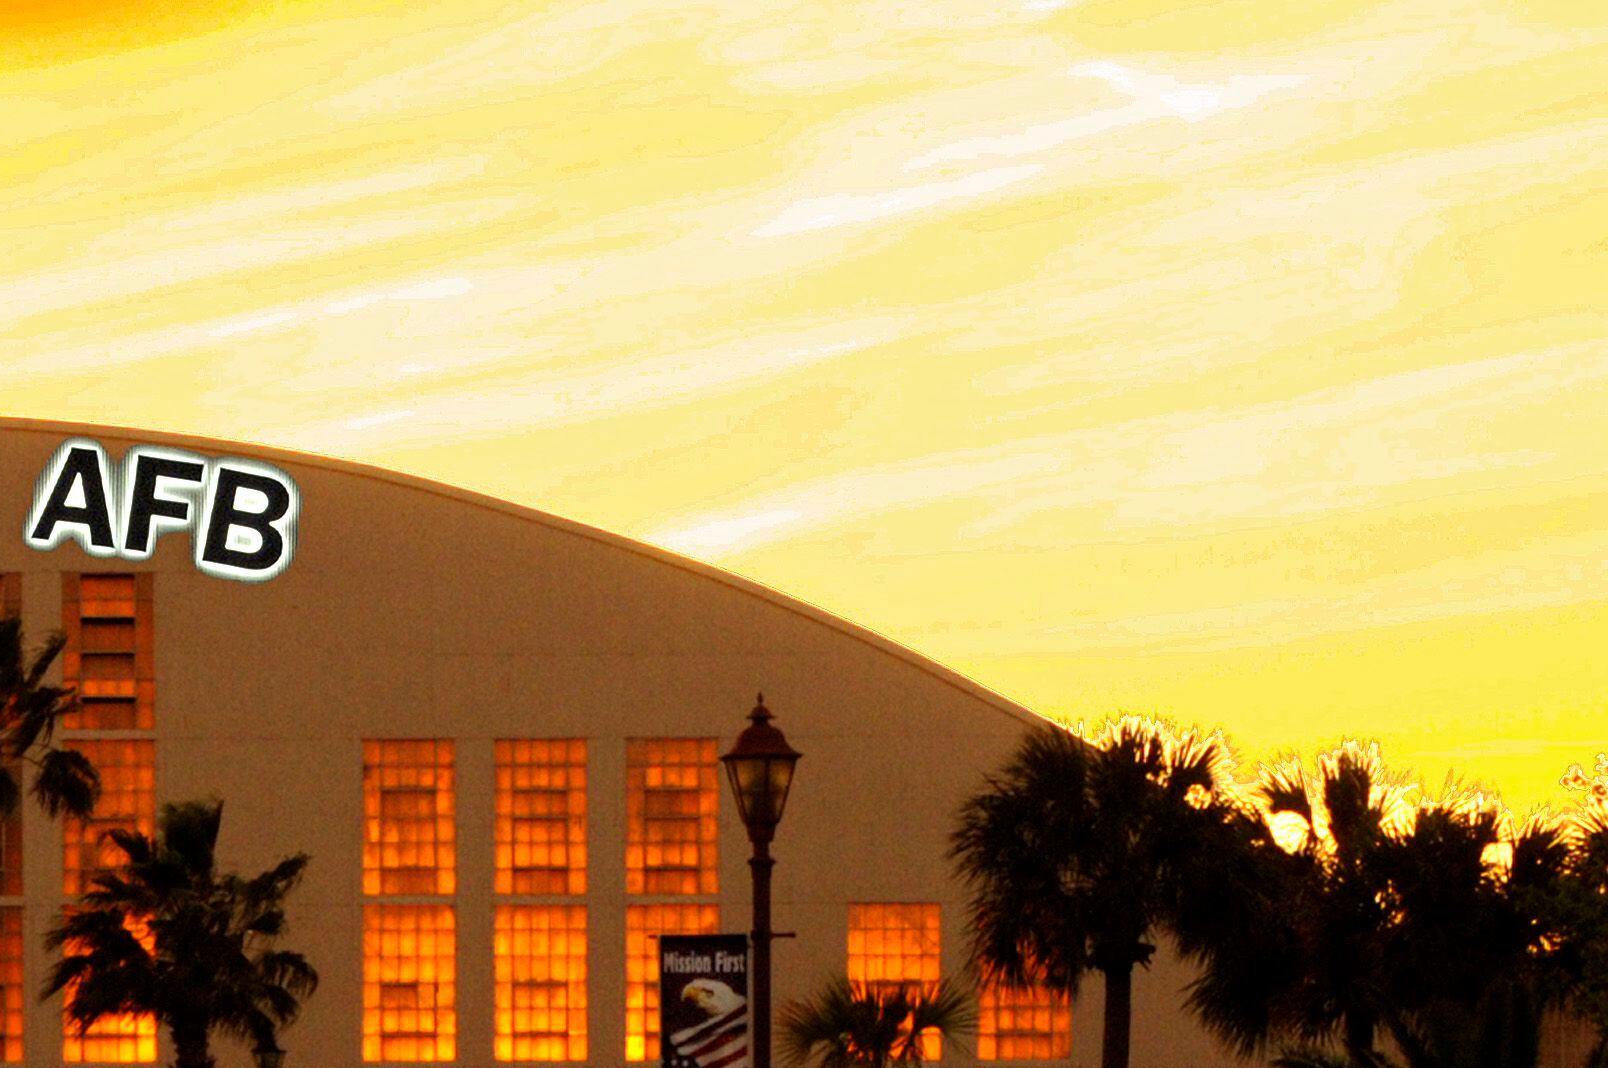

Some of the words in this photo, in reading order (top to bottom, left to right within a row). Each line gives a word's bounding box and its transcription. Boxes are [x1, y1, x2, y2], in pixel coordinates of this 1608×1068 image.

[31, 446, 291, 571] AFB
[663, 951, 711, 973] Mission
[714, 951, 745, 973] First
